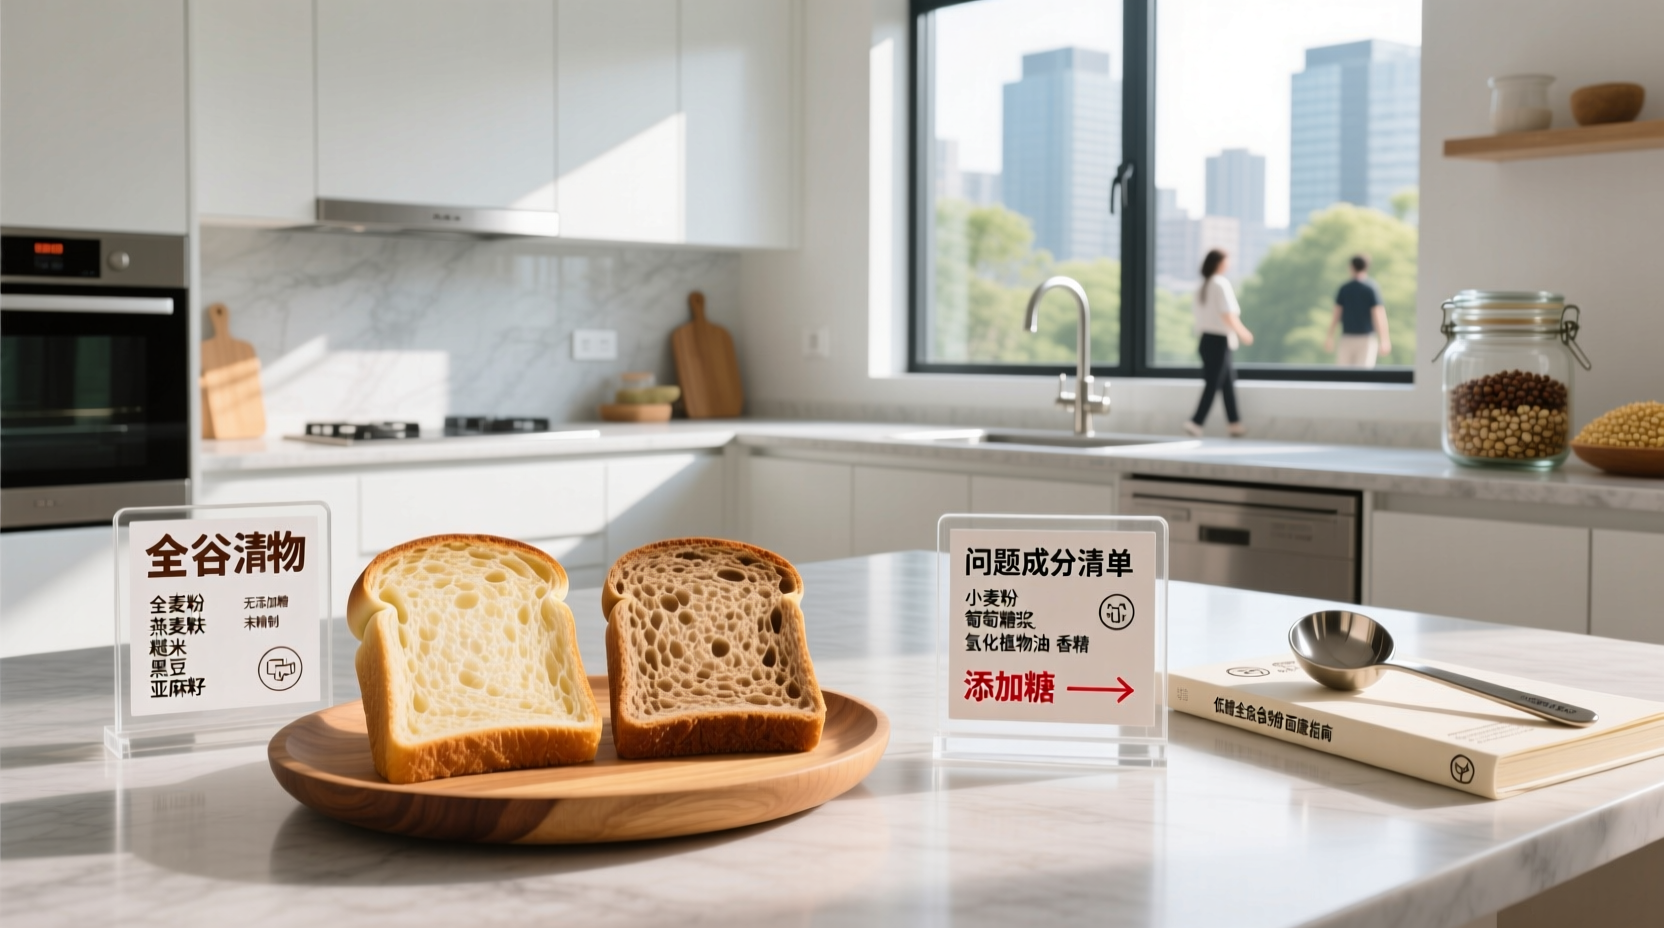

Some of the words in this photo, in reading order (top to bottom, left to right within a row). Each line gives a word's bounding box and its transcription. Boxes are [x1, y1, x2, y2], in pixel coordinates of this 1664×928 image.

[965, 547, 1134, 578] 问题成分清单
[965, 588, 1019, 608] 小麦粉
[150, 658, 187, 678] 黑豆
[963, 669, 1056, 704] 添加糖
